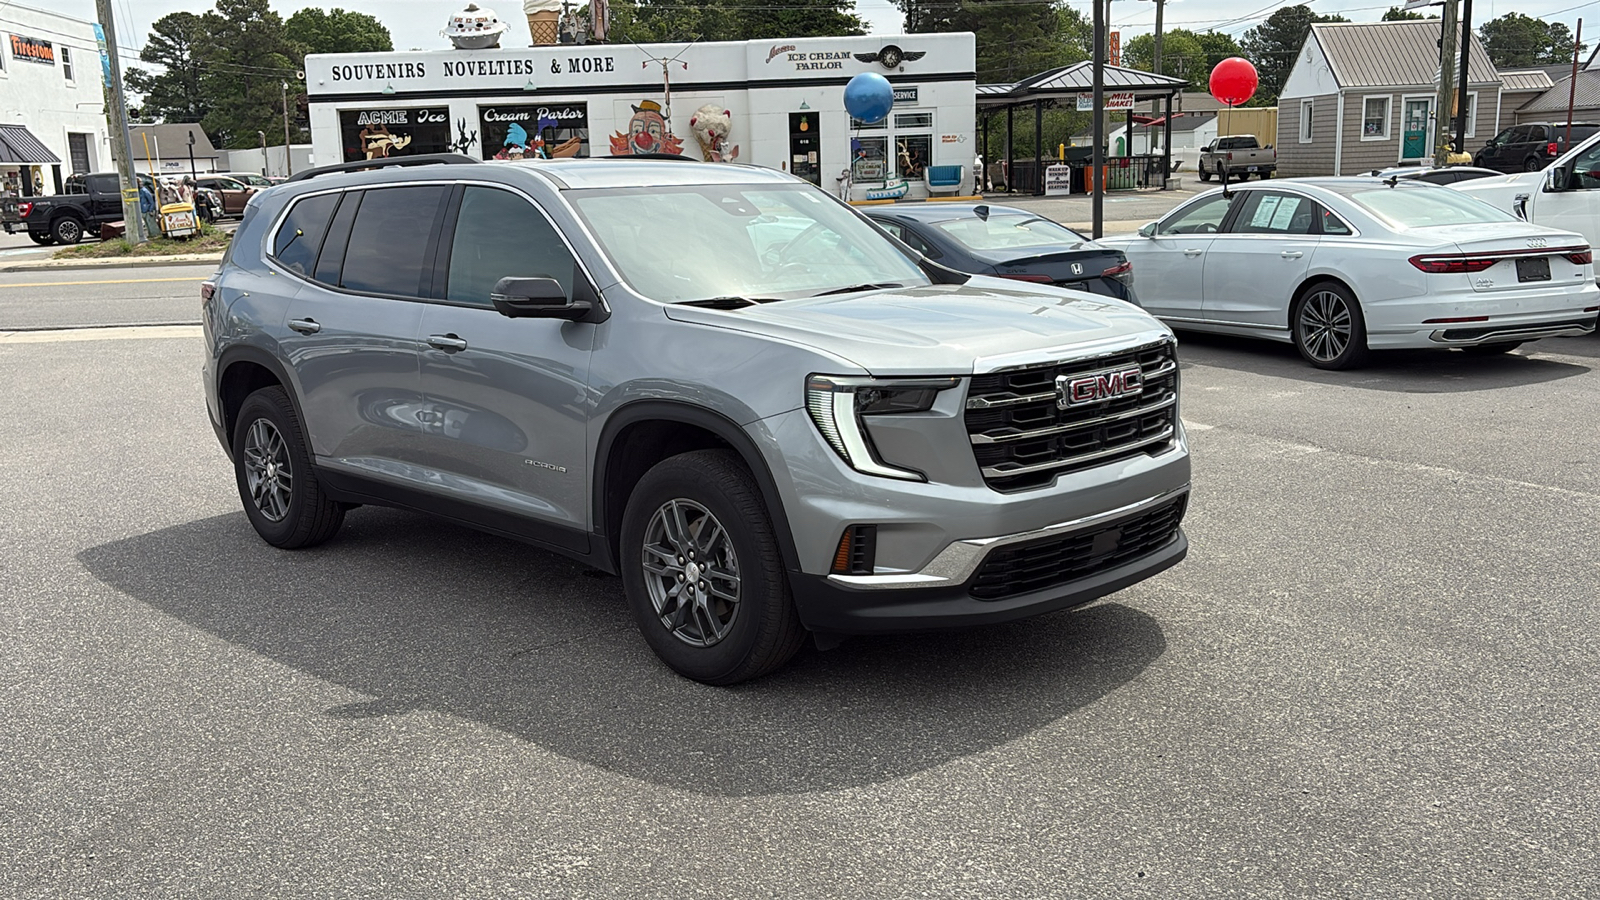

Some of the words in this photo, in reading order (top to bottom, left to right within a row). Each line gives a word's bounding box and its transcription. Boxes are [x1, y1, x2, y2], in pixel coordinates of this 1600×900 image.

[10, 35, 53, 60] Firestone
[787, 53, 806, 61] ICE
[809, 51, 851, 60] CREAM
[332, 62, 426, 80] SOUVENIRS
[443, 59, 534, 77] NOVELTIES
[550, 58, 562, 74] &
[567, 56, 614, 73] MORE
[796, 61, 842, 70] PARLOR
[893, 91, 916, 99] SERVICE
[1105, 100, 1133, 108] SHAKES
[357, 110, 408, 125] ACME
[417, 109, 447, 123] Ice
[483, 108, 531, 122] Cream
[536, 107, 584, 120] Parlor
[1070, 368, 1142, 402] GMC
[524, 459, 567, 473] ACADIA
